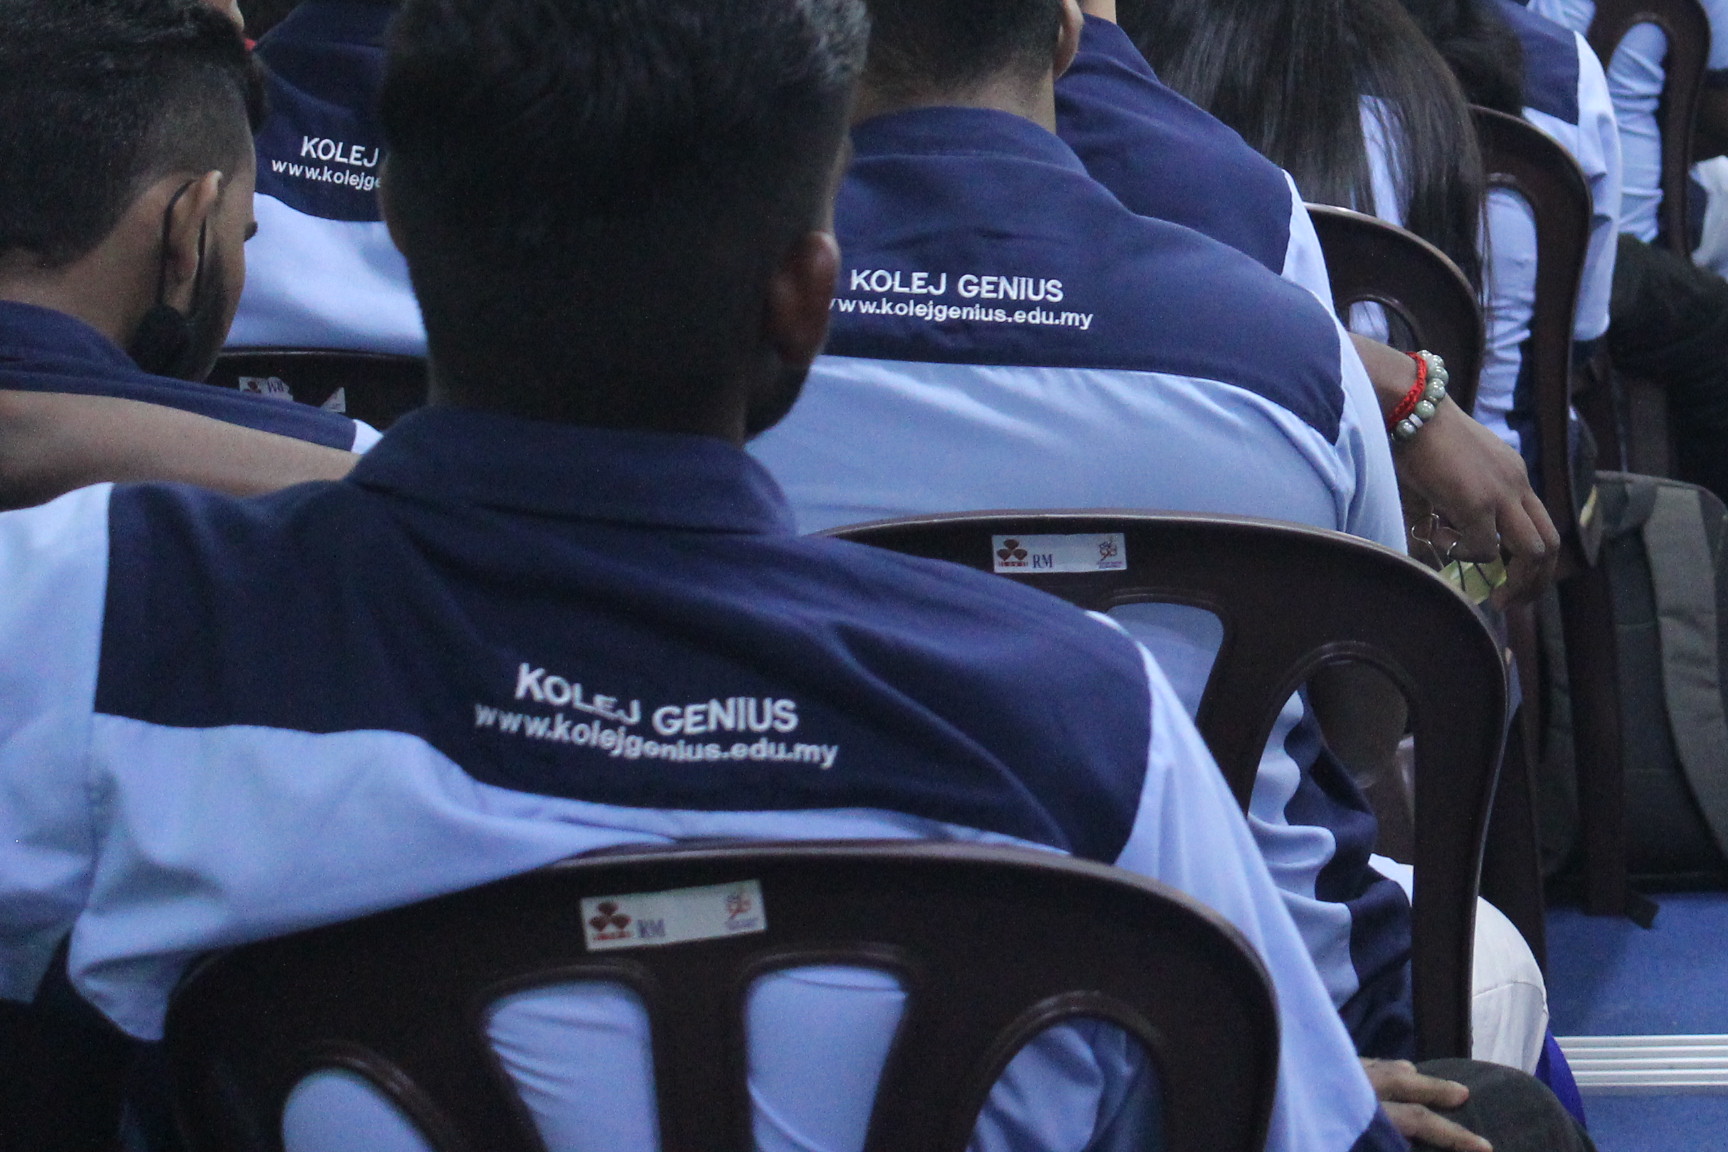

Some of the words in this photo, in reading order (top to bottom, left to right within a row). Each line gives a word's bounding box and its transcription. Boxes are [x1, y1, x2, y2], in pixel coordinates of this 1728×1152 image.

[300, 135, 380, 167] KOLEJ
[850, 269, 947, 297] KOLEJ
[957, 274, 1065, 303] GENIUS
[1032, 553, 1054, 569] RM
[515, 662, 640, 725] KOLEJ
[652, 696, 799, 736] GENIUS
[473, 701, 838, 770] www.kolejgenius.edu.my
